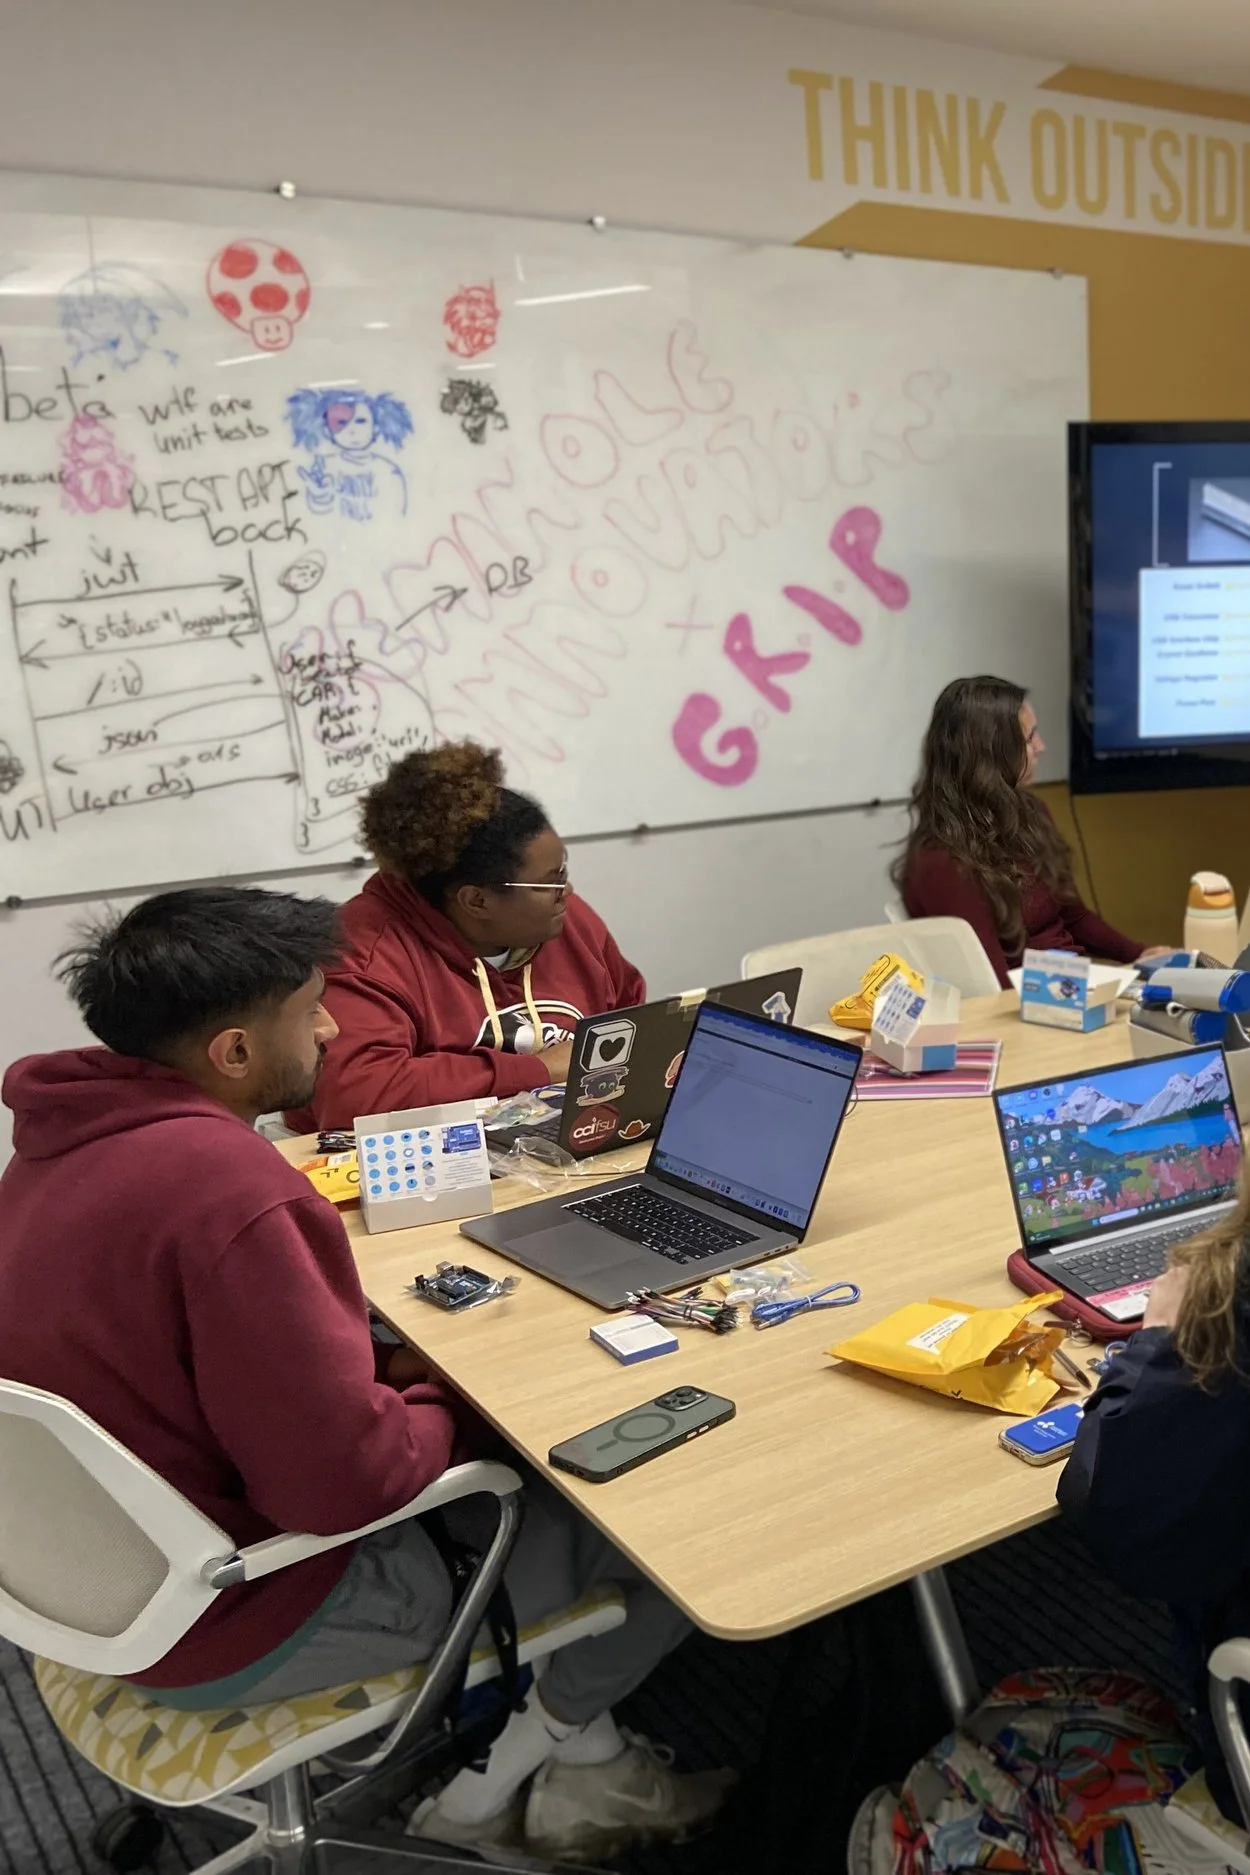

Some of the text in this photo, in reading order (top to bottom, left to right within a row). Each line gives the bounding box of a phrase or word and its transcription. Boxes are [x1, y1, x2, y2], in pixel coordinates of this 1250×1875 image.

[787, 67, 1011, 205] THINK
[153, 422, 207, 455] unit
[128, 458, 300, 524] REST API
[198, 496, 310, 547] back
[485, 555, 533, 597] DB
